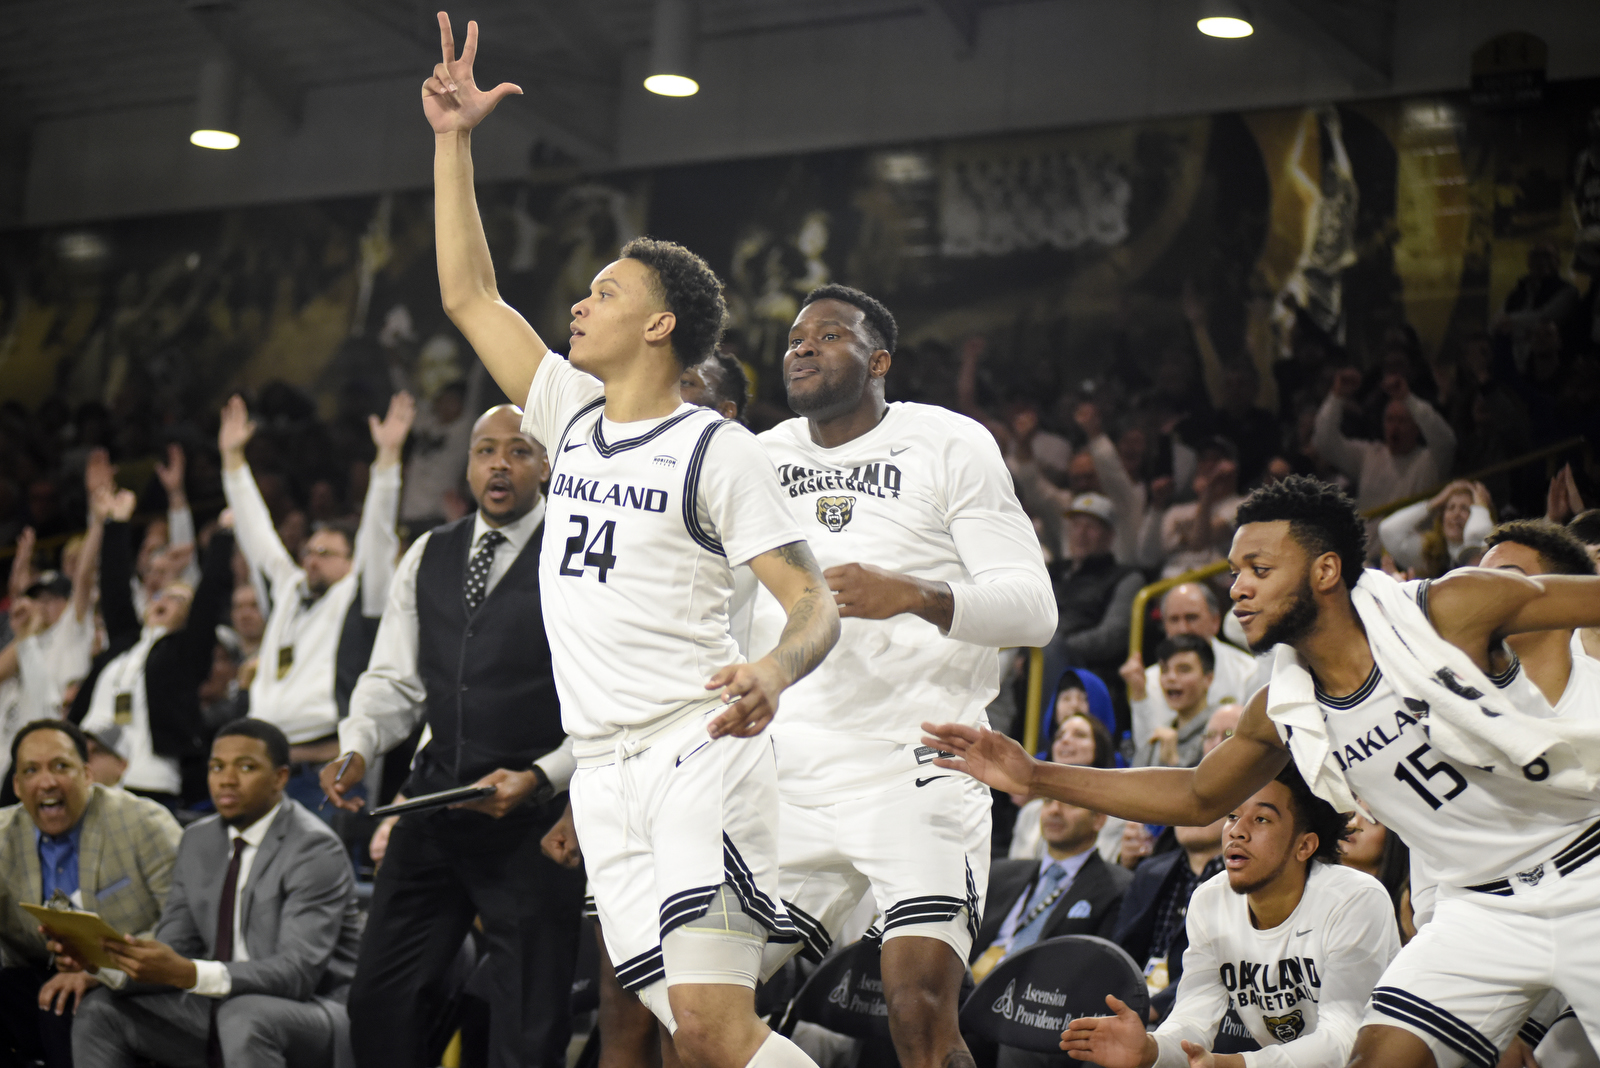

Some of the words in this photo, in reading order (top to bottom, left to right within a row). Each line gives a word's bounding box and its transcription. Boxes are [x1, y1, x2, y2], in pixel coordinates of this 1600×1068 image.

[553, 473, 669, 513] OAKLAND
[788, 475, 886, 499] BASKETBALL
[559, 514, 617, 583] 24
[1393, 742, 1469, 811] 15
[1219, 956, 1322, 994] OAKLAND
[1022, 982, 1068, 1007] Ascension
[1014, 1004, 1063, 1031] Providence
